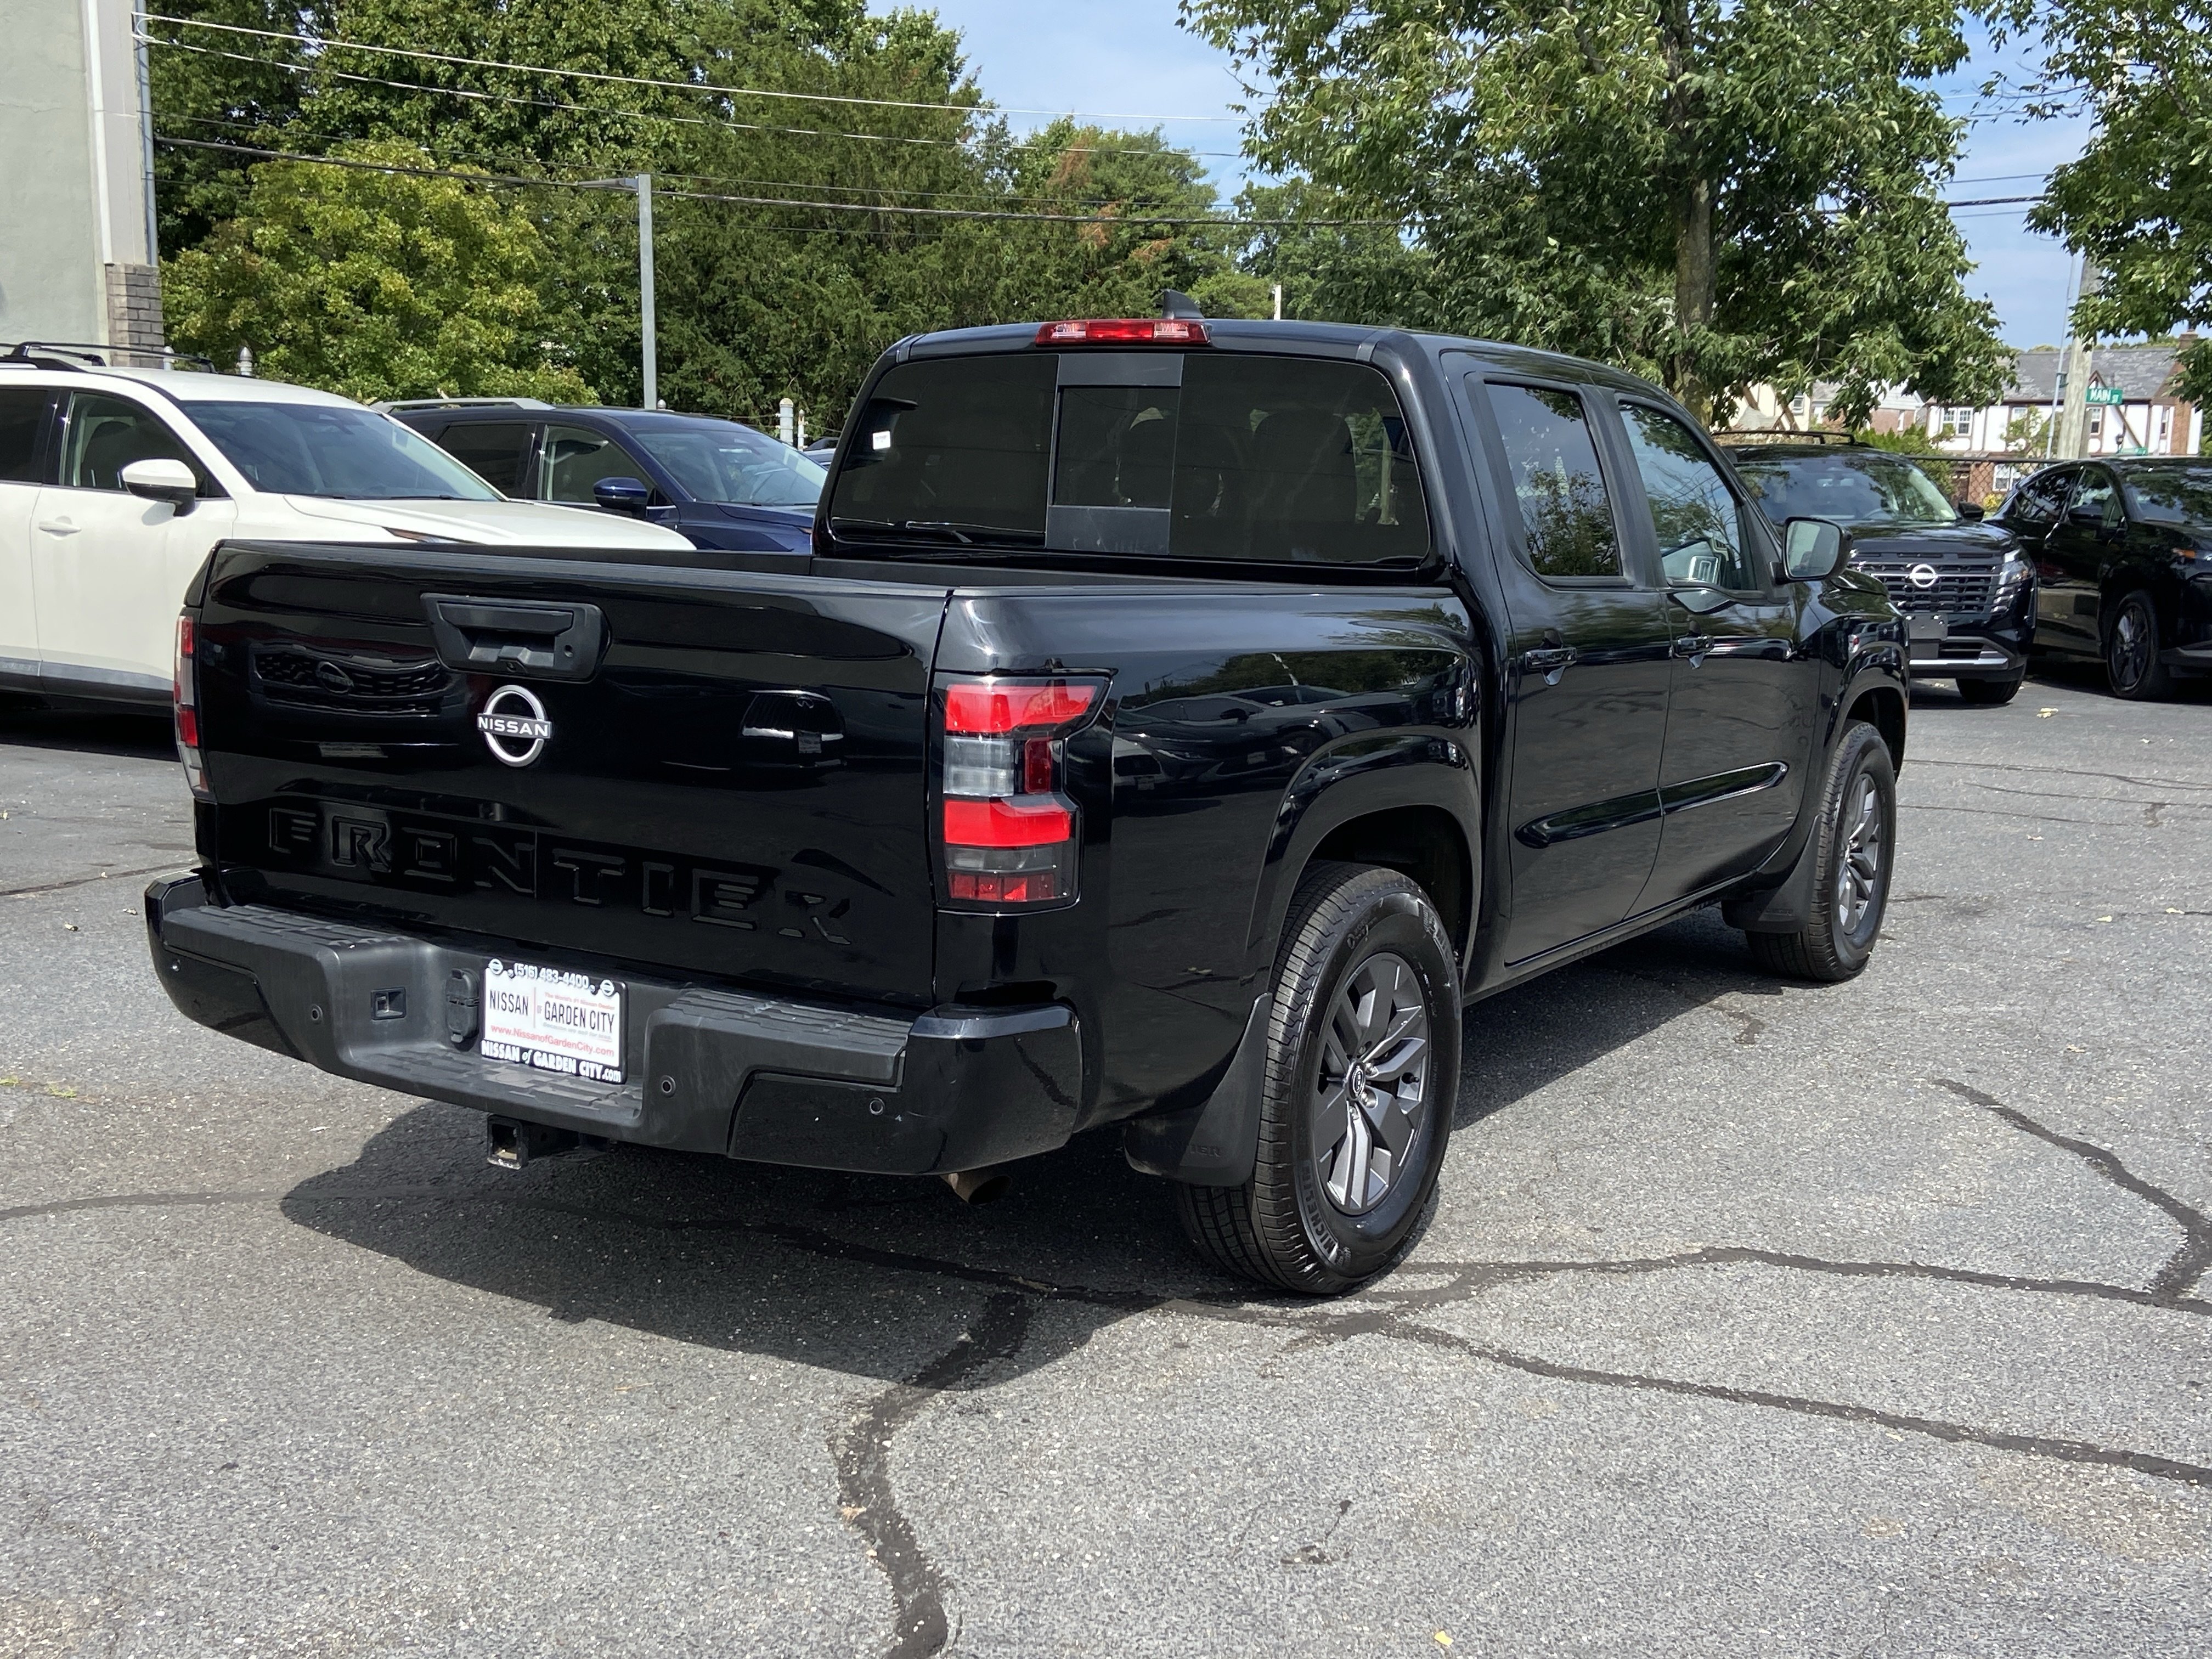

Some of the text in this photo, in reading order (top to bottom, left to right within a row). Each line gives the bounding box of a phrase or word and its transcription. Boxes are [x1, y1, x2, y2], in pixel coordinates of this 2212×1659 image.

[2090, 388, 2111, 401] MAIN
[478, 716, 549, 737] NISSAN
[268, 806, 853, 946] FRONTIER
[514, 962, 590, 990] (516) 483-4400
[489, 989, 529, 1016] NISSAN
[544, 1000, 586, 1029] GARDEN
[589, 1009, 614, 1034] CITY
[481, 1039, 521, 1063] NISSAN
[522, 1049, 533, 1064] of
[533, 1050, 577, 1074] GARDEN
[490, 1024, 615, 1057] www.NissanofGardenCity.com
[1301, 1165, 1335, 1255] MICHELIN
